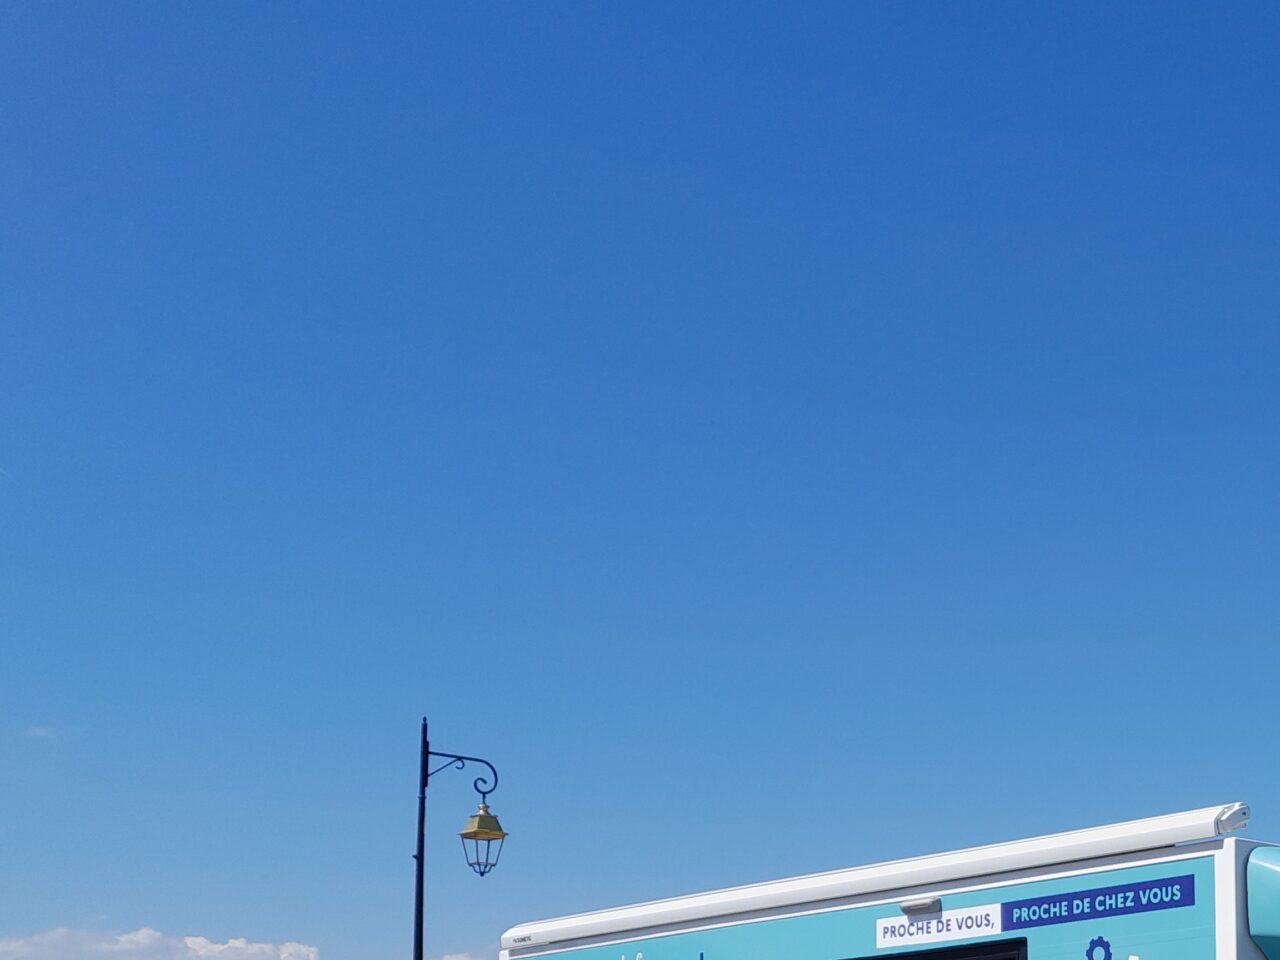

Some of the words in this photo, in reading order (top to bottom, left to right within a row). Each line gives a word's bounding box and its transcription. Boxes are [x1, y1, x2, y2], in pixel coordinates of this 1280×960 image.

[1012, 901, 1068, 923] PROCHE
[1072, 898, 1091, 915] DE
[1095, 892, 1135, 911] CHEZ
[1139, 884, 1181, 905] VOUS
[883, 921, 931, 939] PROCHE
[936, 919, 951, 933] DE
[955, 913, 994, 930] VOUS,
